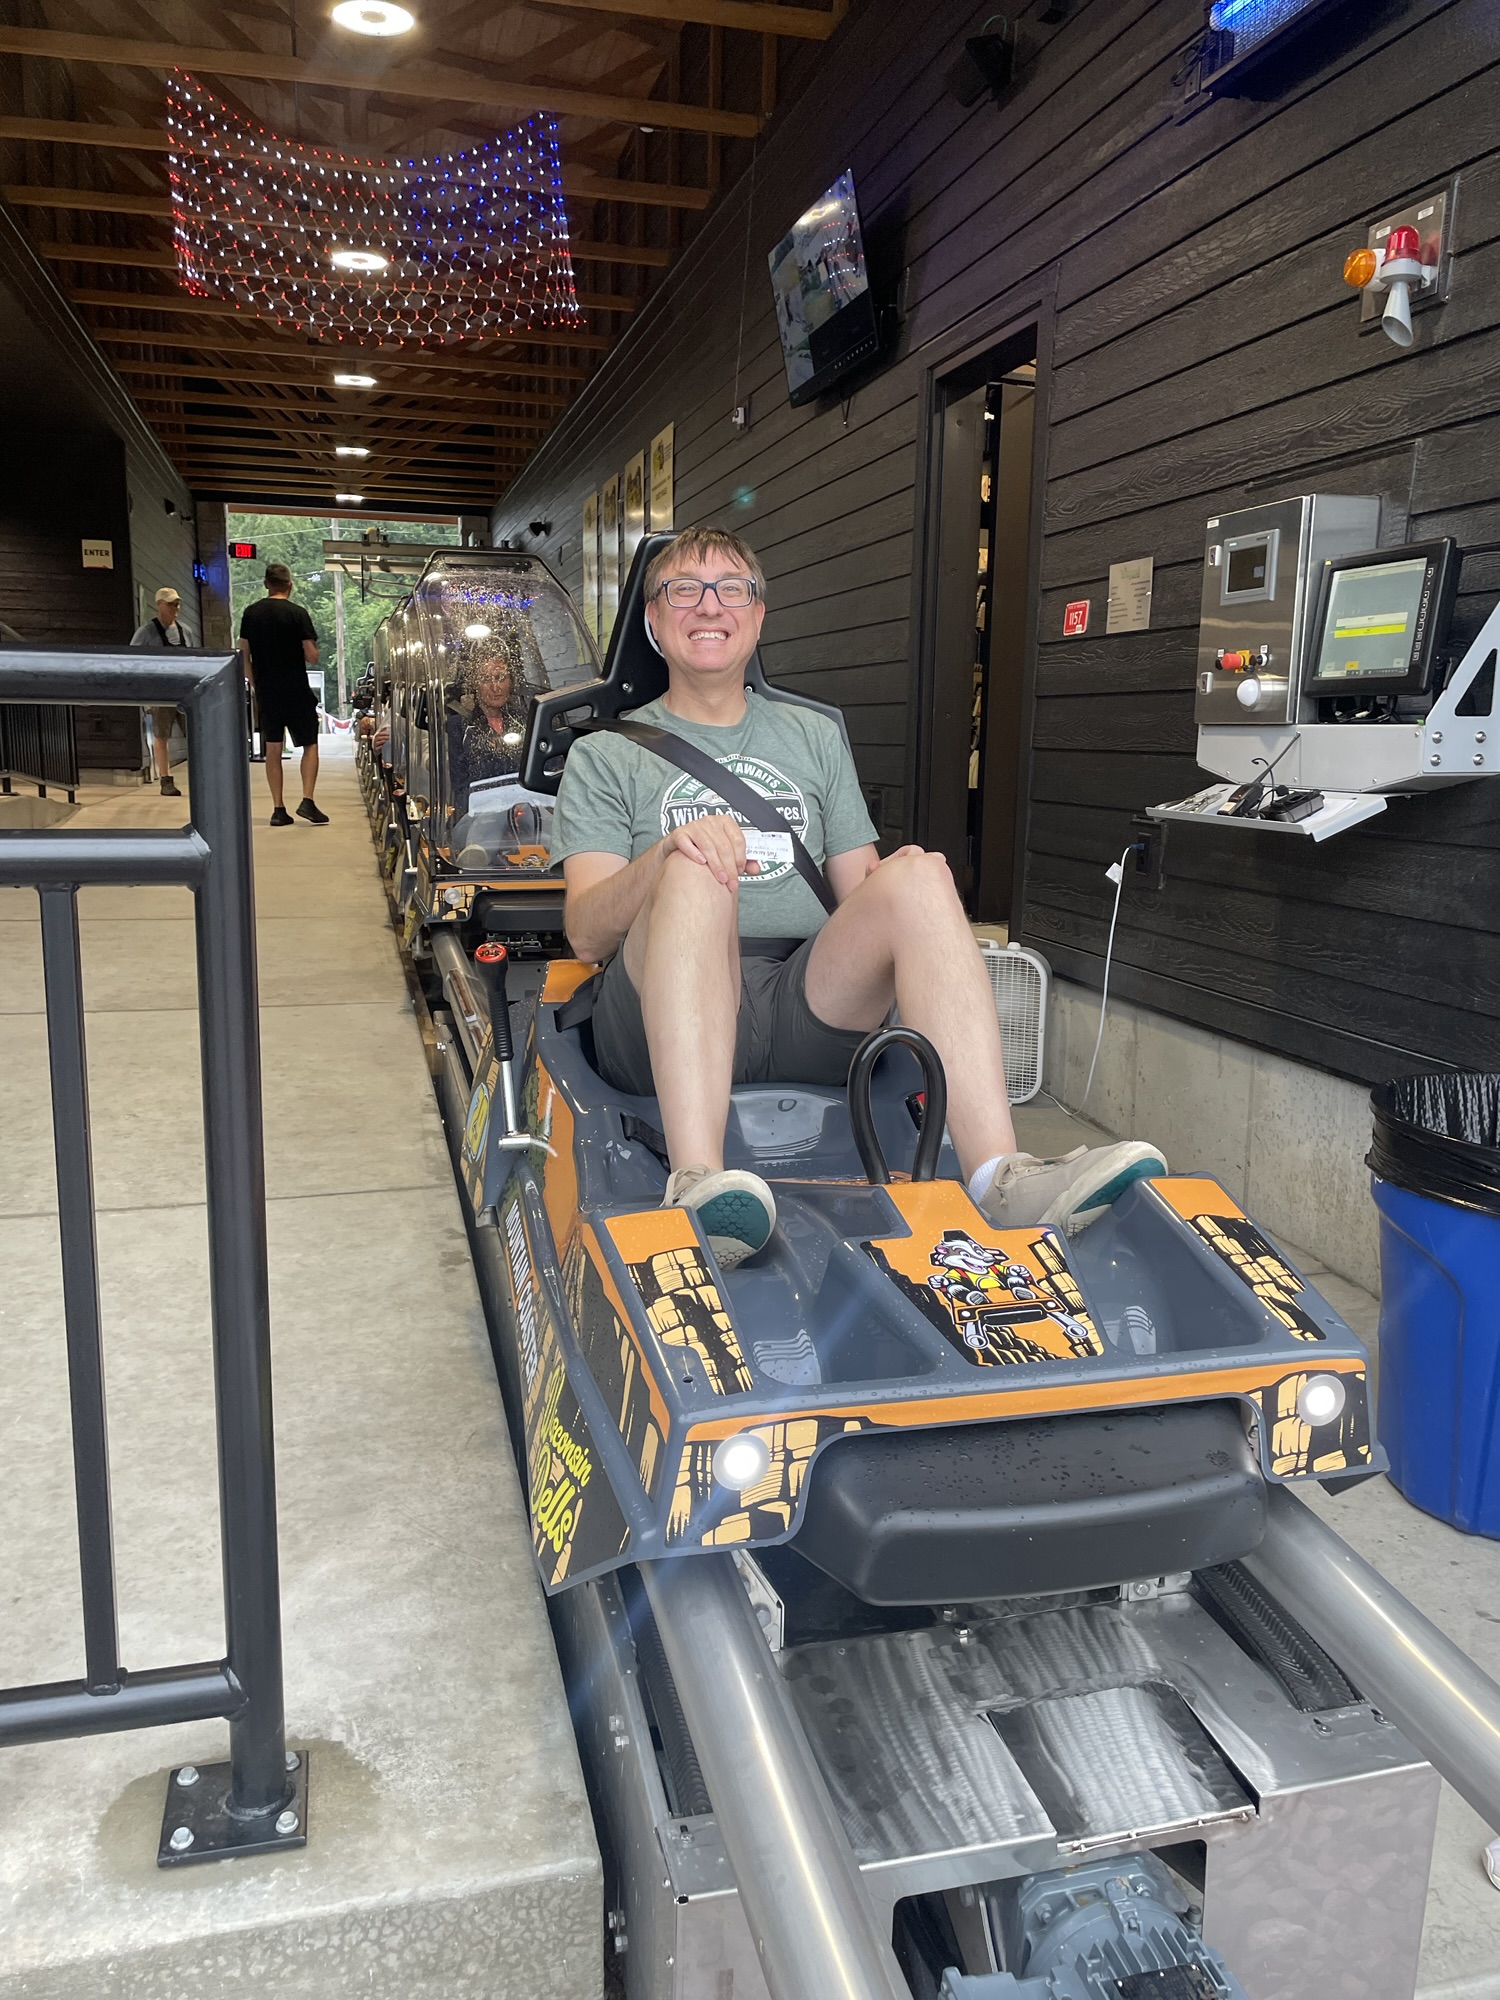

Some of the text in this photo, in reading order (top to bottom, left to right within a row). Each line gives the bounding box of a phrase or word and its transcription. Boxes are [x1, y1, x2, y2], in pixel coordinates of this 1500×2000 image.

[84, 549, 110, 557] ENTER
[235, 543, 252, 557] EXIT
[1068, 610, 1083, 626] 1157
[735, 761, 781, 789] AWAITS
[671, 807, 709, 827] Wild
[505, 1199, 530, 1295] MOUNTAIN
[517, 1280, 538, 1394] COASTER
[541, 1365, 593, 1488] Wisconsin
[531, 1442, 577, 1553] Dells
